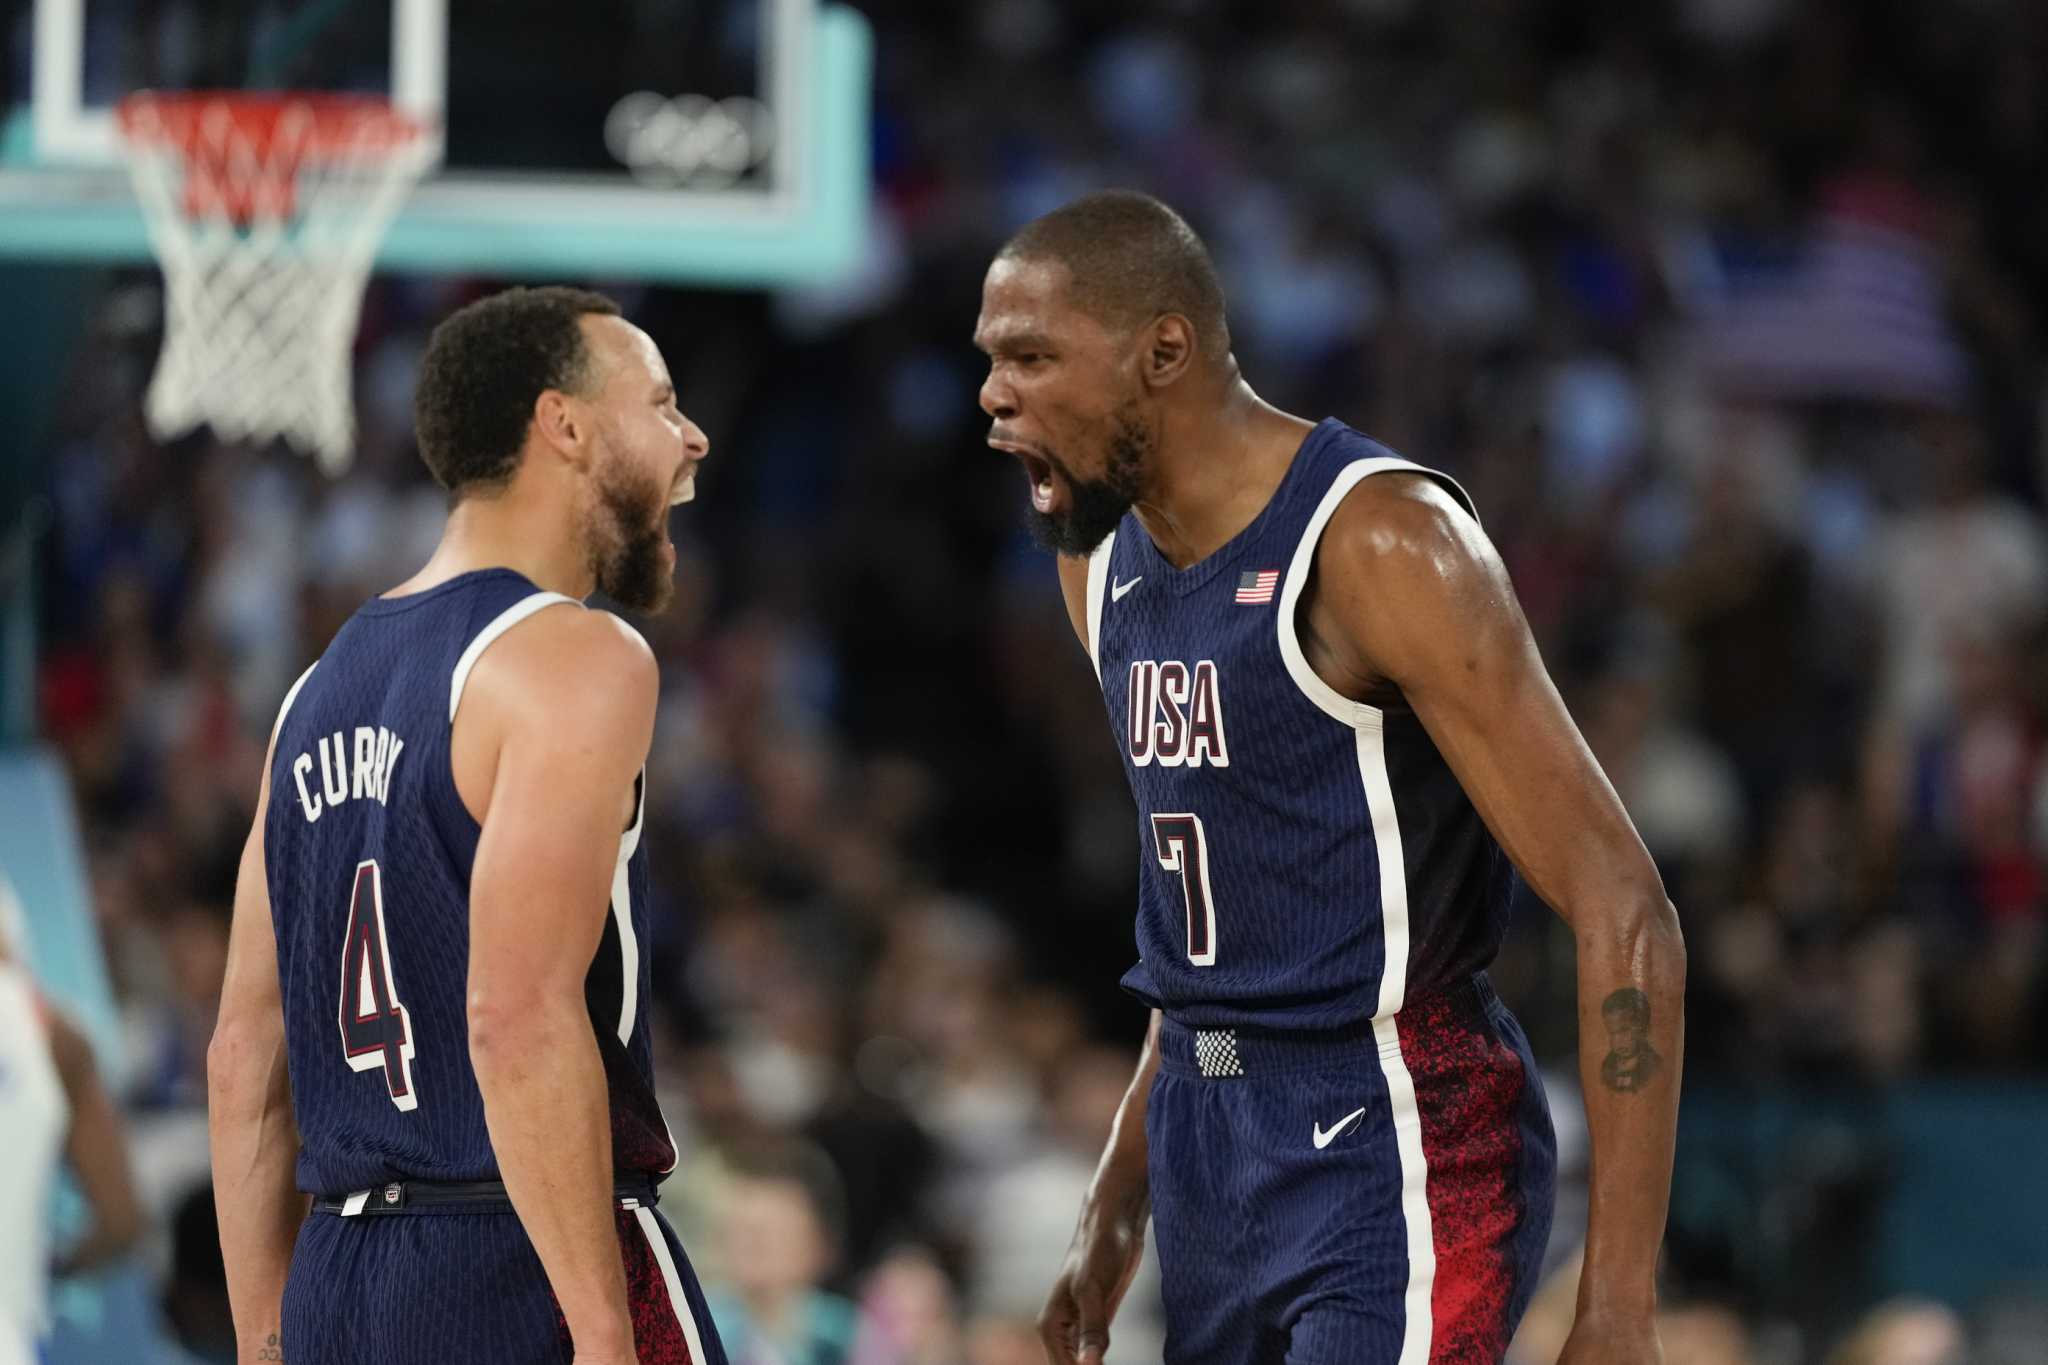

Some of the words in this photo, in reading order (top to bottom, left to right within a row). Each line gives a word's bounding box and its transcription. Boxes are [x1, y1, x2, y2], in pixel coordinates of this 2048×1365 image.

[293, 726, 403, 823] CURRY
[1128, 660, 1230, 768] USA
[1151, 813, 1216, 967] 7
[338, 859, 418, 1112] 4
